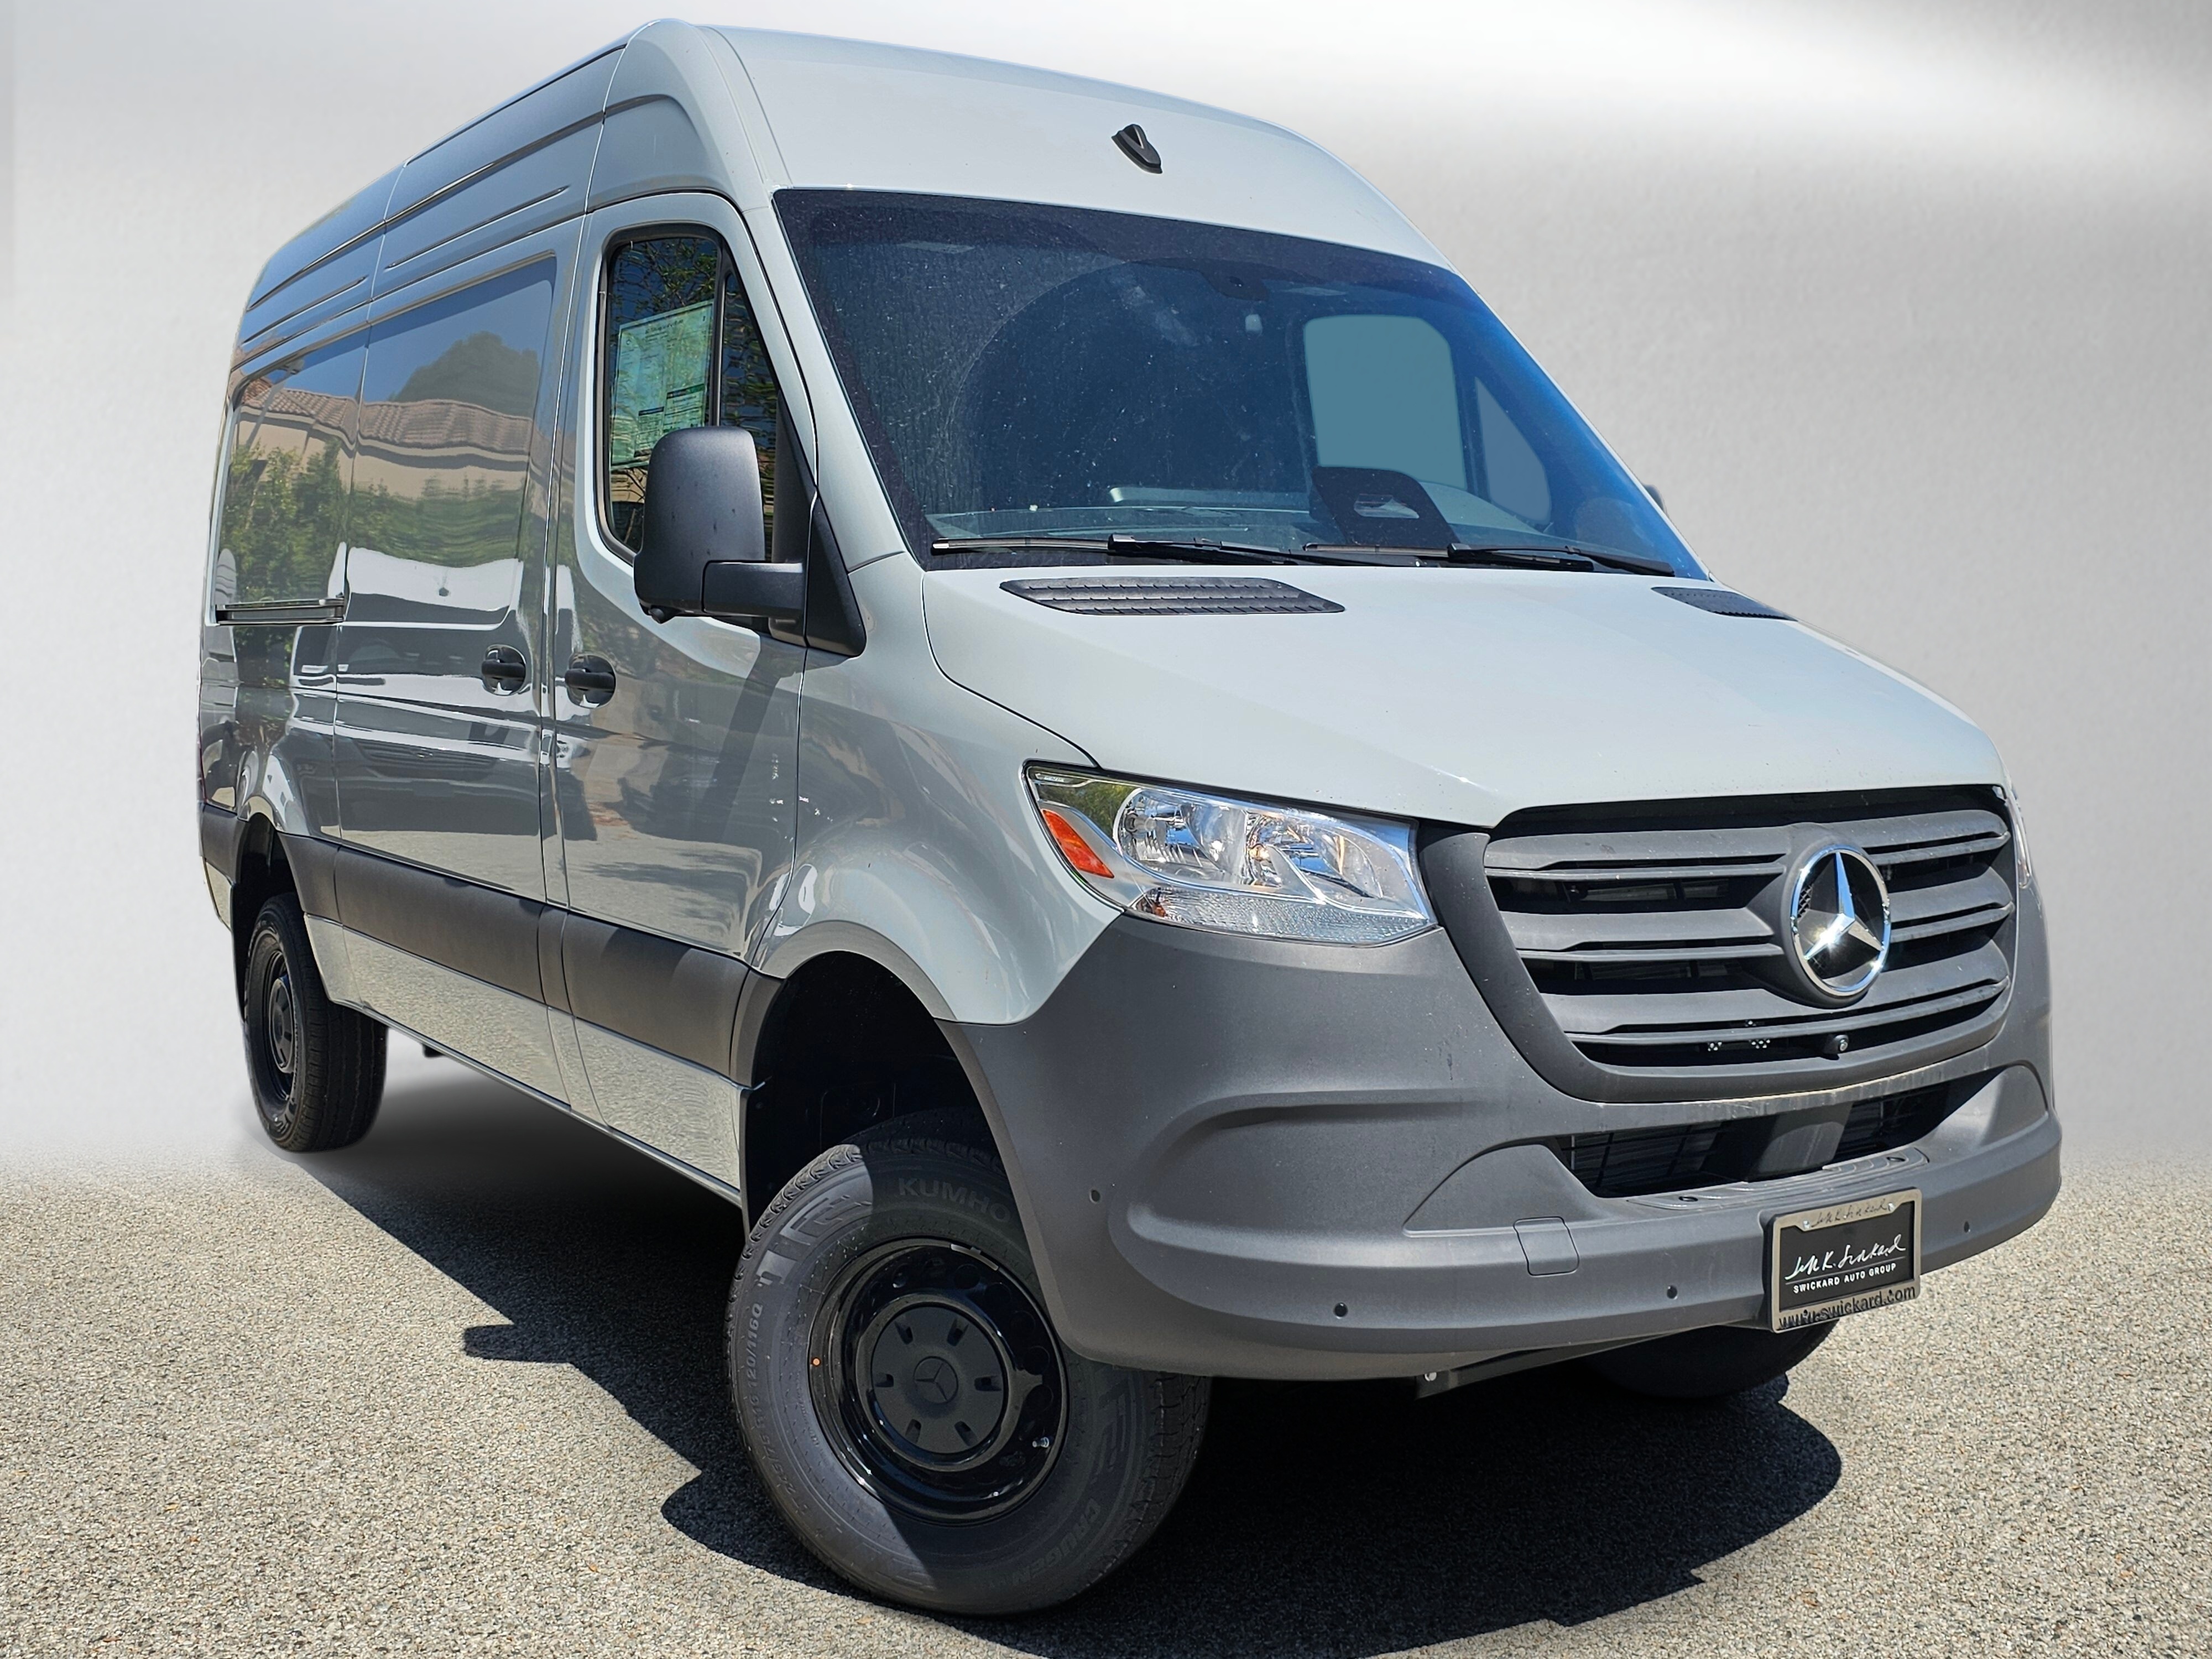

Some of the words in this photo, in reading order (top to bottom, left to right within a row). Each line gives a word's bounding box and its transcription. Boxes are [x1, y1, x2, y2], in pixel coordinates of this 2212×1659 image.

[898, 1177, 1011, 1223] KUMHO
[1793, 1277, 1840, 1294] SWICKARD
[1844, 1270, 1866, 1284] AUTO
[1868, 1262, 1897, 1277] GROUP
[745, 1302, 764, 1388] 120/116Q
